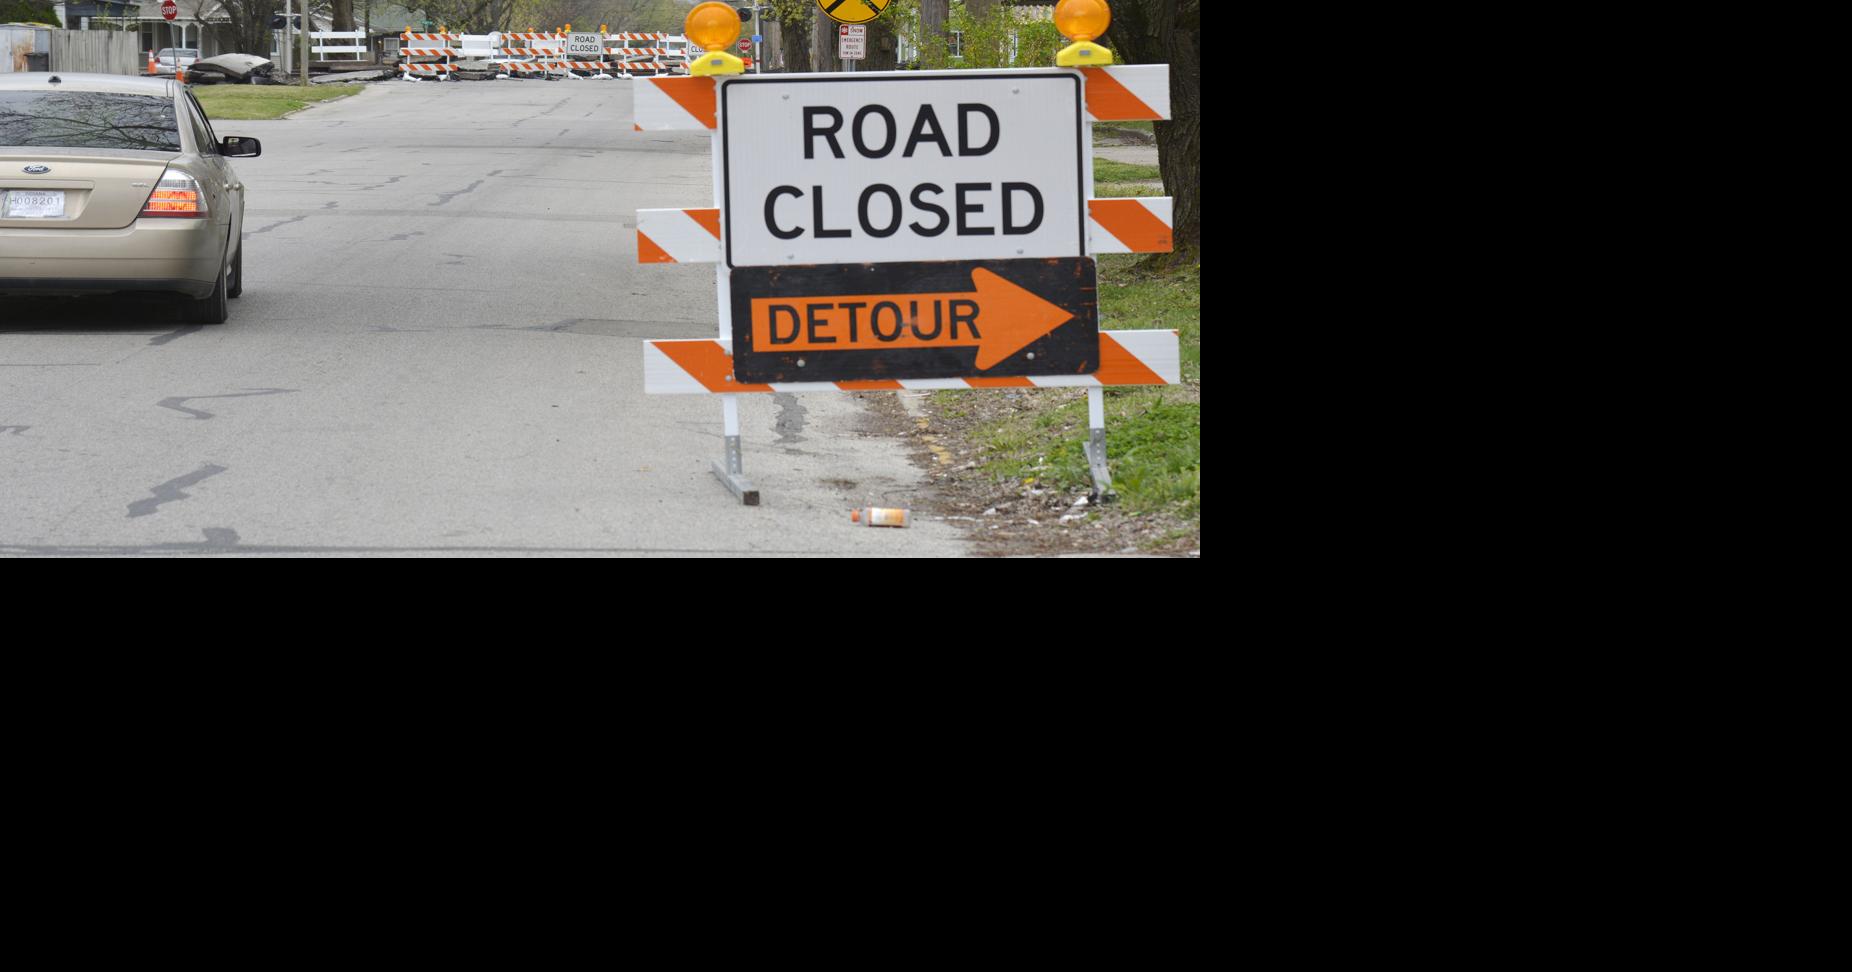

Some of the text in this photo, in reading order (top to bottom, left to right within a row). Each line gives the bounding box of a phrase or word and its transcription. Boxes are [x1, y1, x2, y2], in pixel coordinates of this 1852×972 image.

[162, 6, 176, 15] STOP
[570, 44, 599, 52] CLOSED
[574, 35, 596, 43] ROAD
[802, 102, 1000, 160] ROAD
[763, 181, 1045, 240] CLOSED
[768, 299, 982, 345] DETOUR
